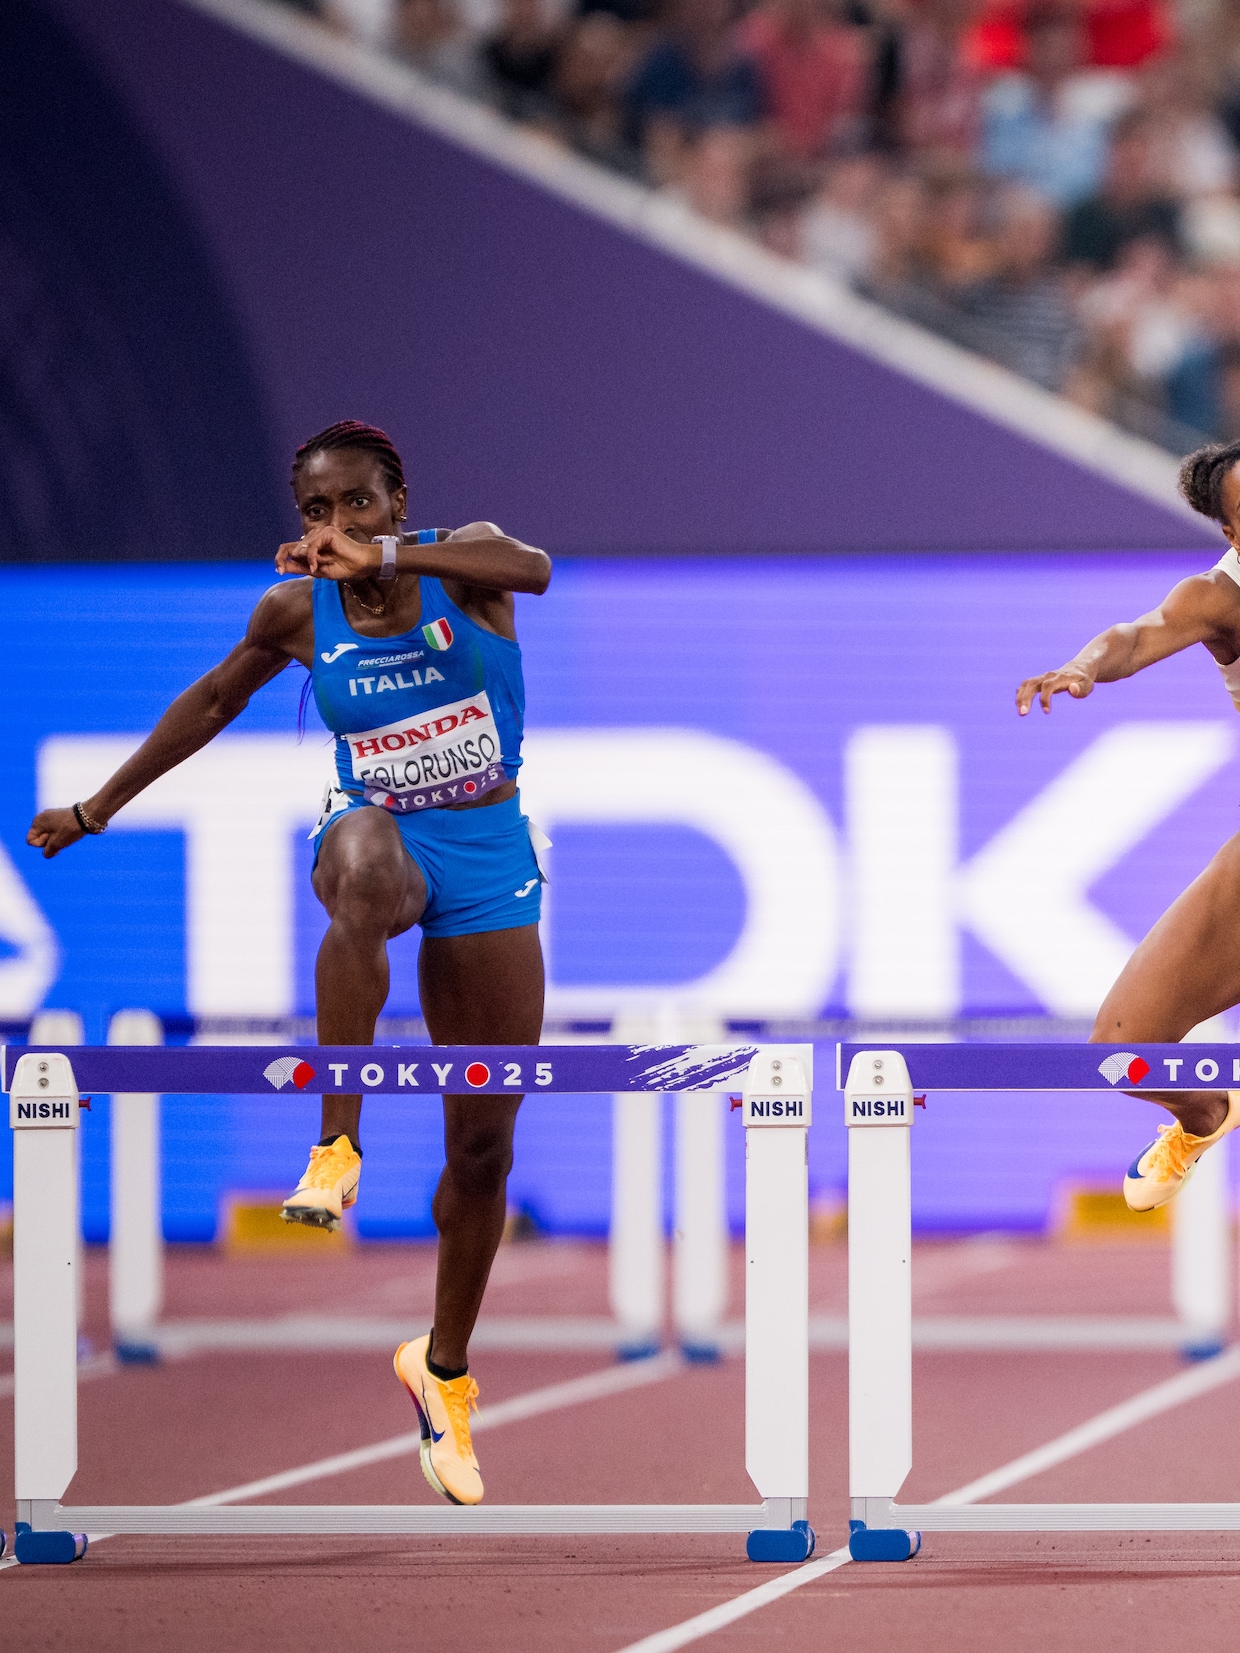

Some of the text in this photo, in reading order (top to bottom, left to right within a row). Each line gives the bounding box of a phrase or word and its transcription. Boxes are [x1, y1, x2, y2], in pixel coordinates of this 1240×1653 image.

[357, 650, 425, 667] FRECCIAROSSA
[348, 666, 446, 697] ITALIA
[352, 705, 489, 760] HONDA
[36, 721, 1240, 1019] TDK
[17, 1103, 70, 1119] NISHI
[750, 1100, 803, 1117] NISHI
[852, 1100, 905, 1117] NISHI
